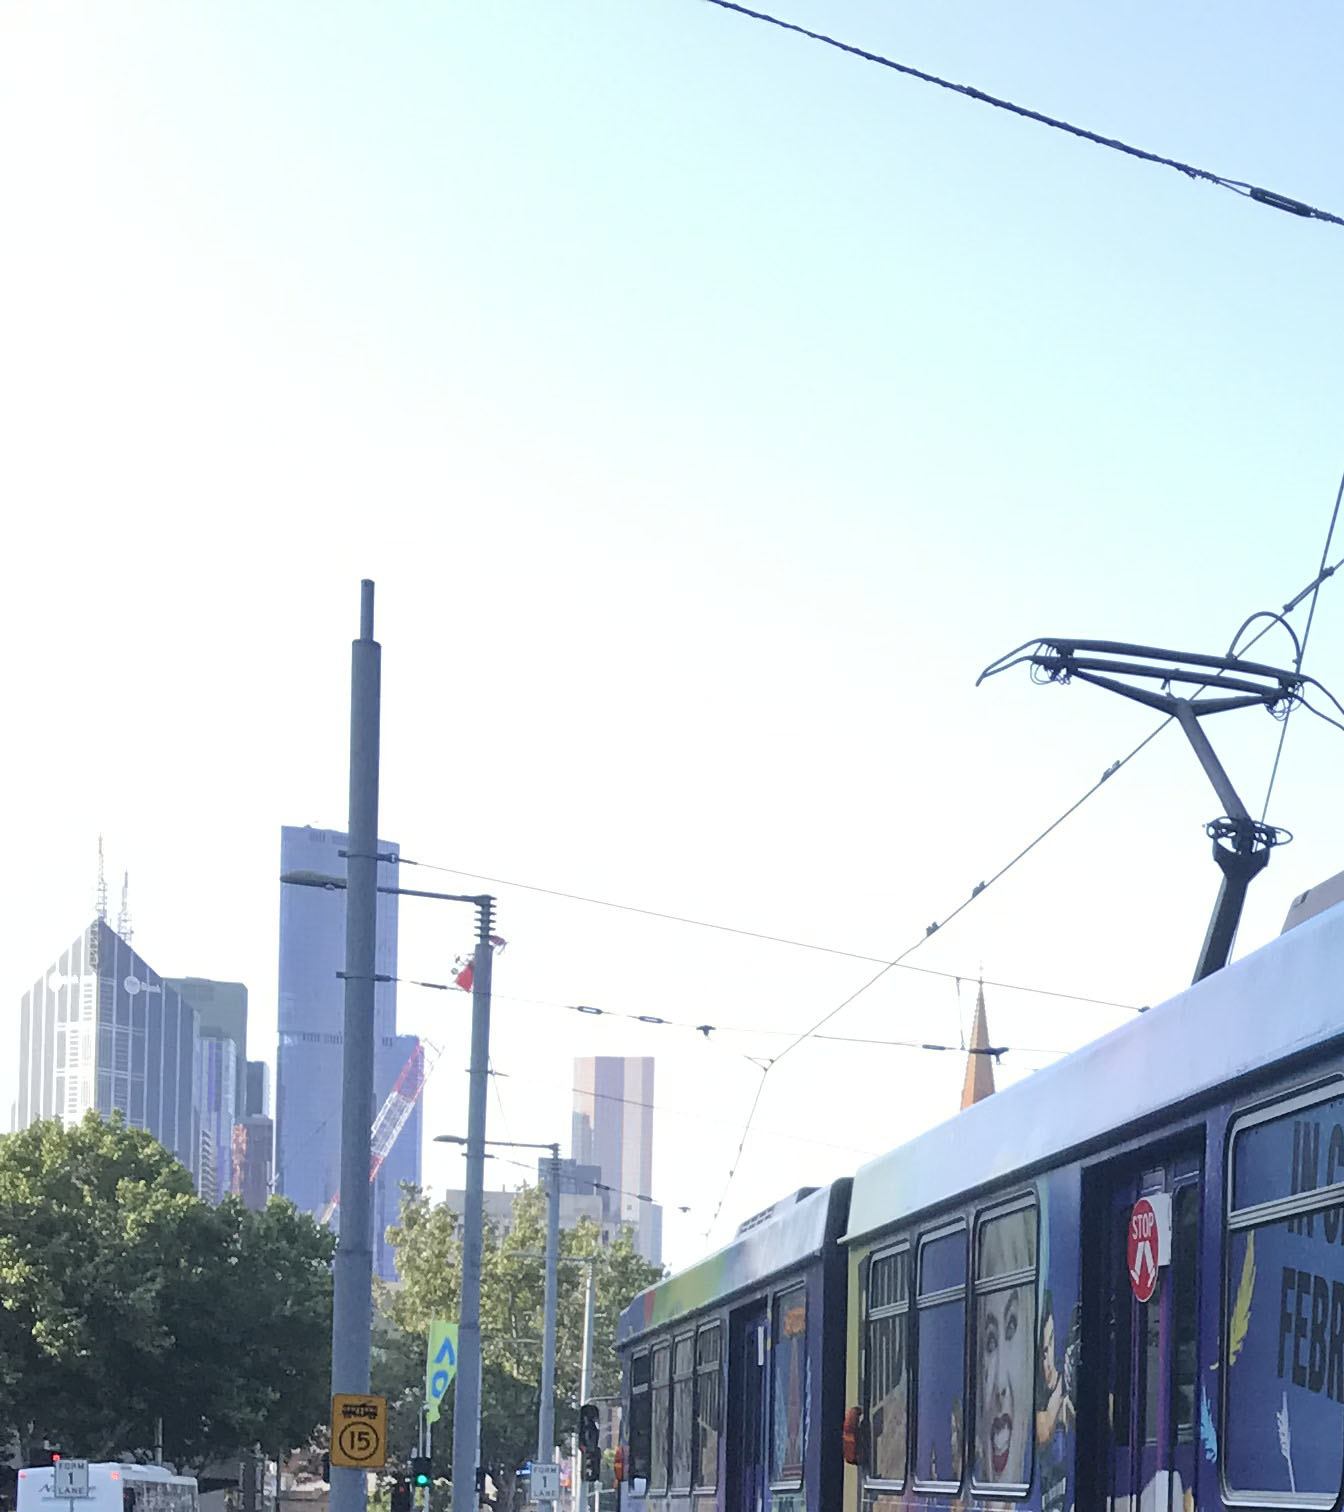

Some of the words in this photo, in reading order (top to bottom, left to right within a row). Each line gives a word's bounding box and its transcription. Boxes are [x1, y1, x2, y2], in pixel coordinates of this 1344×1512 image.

[1132, 1212, 1154, 1240] STOP
[350, 1430, 371, 1451] 15
[59, 1462, 85, 1470] FORM
[68, 1471, 74, 1486] 1
[542, 1475, 547, 1488] 1
